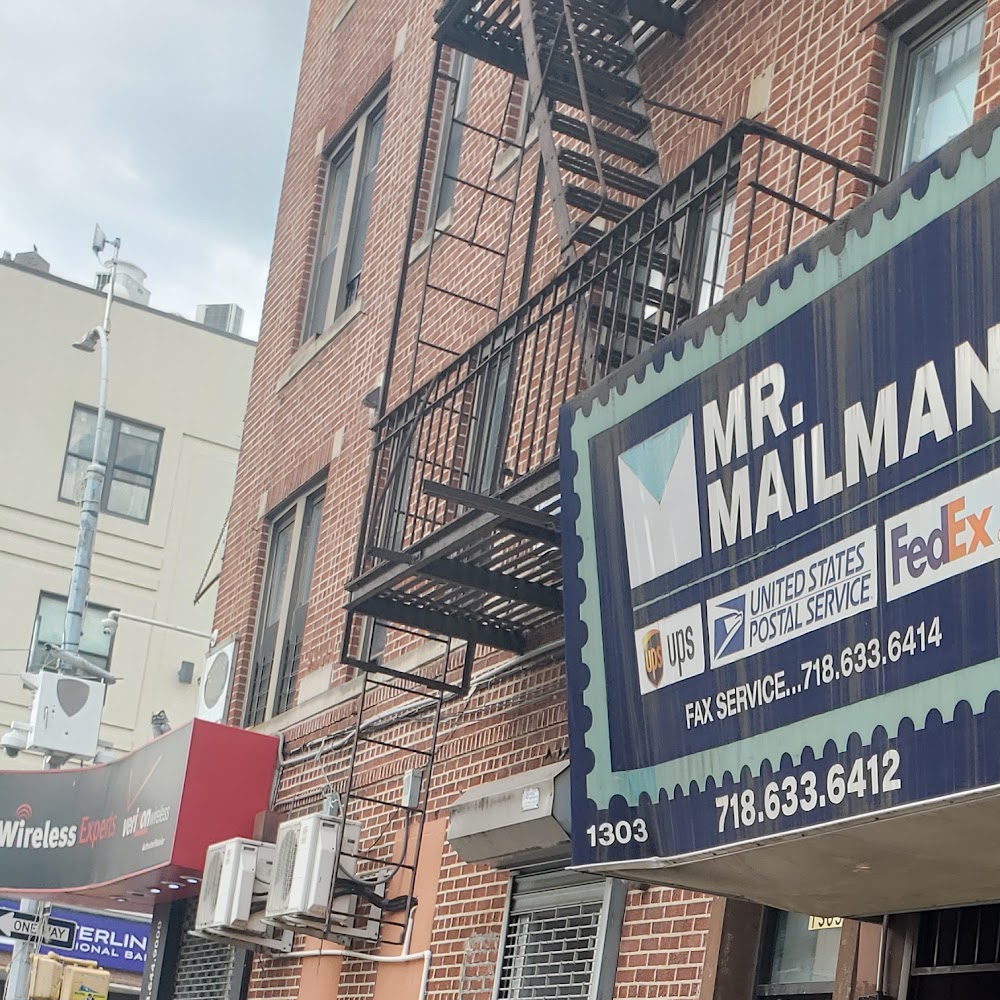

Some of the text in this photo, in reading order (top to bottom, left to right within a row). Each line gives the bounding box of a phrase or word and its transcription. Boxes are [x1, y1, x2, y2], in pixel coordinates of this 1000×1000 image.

[703, 362, 804, 474] MR.
[891, 496, 994, 586] FedEx
[750, 542, 865, 616] UNITED STATES
[750, 573, 871, 647] POSTAL SERVICE
[667, 625, 695, 676] ups
[685, 699, 714, 729] FAX
[715, 748, 901, 832] 718.633.6412
[0, 819, 77, 849] Wireless
[79, 815, 117, 848] Experts
[587, 818, 649, 847] 1303
[14, 920, 66, 939] ONE AY
[77, 924, 148, 951] ERLIN
